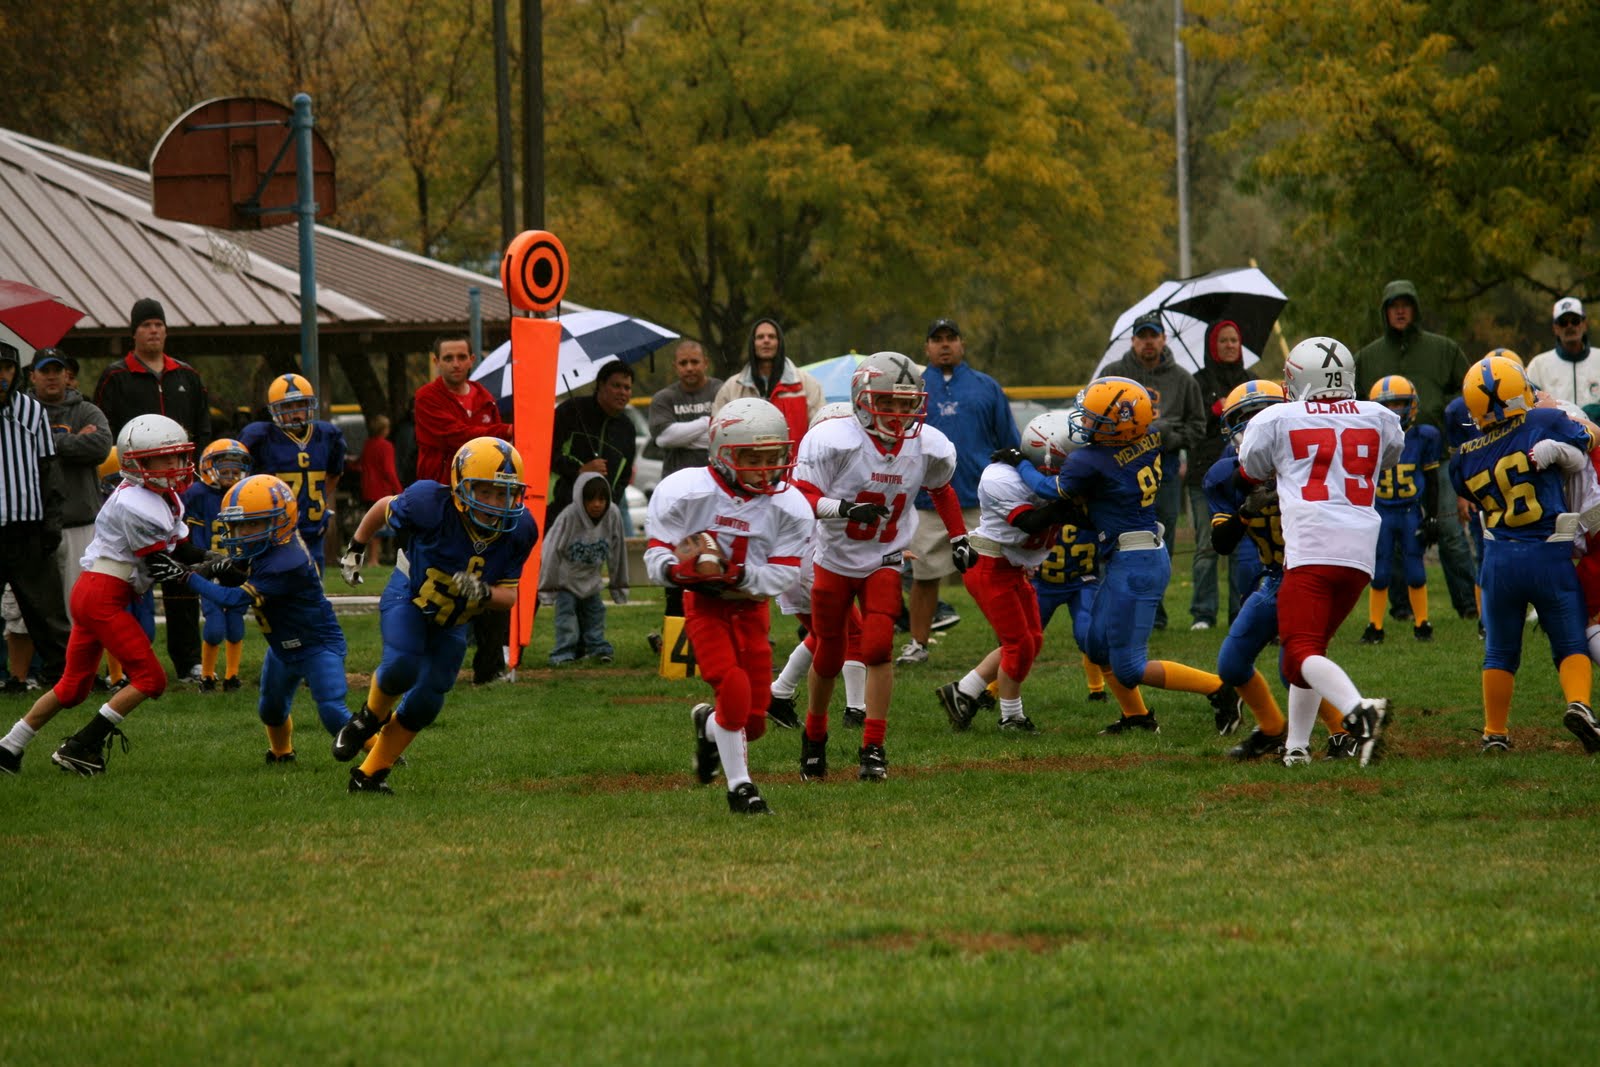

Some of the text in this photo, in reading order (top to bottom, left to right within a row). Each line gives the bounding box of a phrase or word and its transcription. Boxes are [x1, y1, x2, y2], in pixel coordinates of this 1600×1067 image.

[1325, 372, 1342, 388] 79
[1304, 400, 1361, 415] CLARK
[297, 452, 310, 468] C
[1289, 428, 1381, 507] 79
[871, 472, 903, 485] BOUNTIFUL
[1465, 451, 1543, 528] 56
[275, 470, 327, 521] 75
[1062, 524, 1077, 543] C
[1041, 543, 1095, 583] 23
[671, 621, 698, 678] 4
